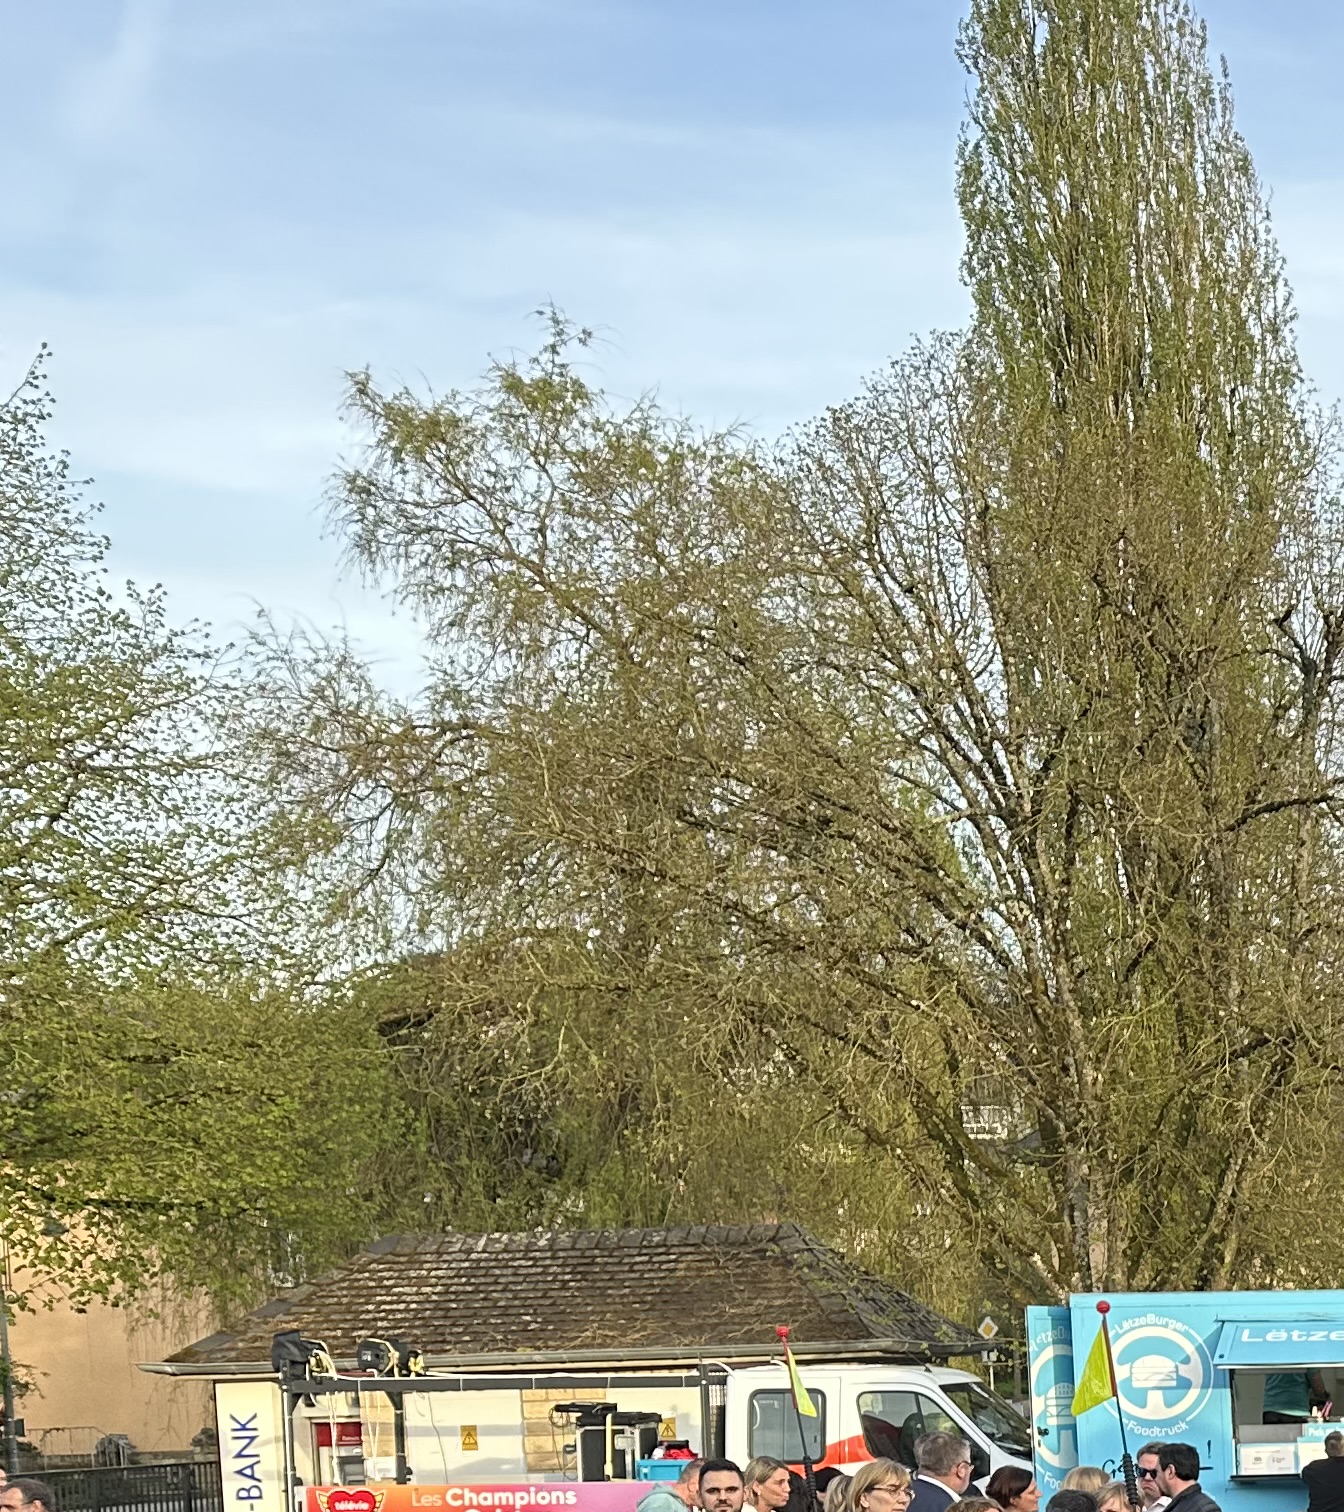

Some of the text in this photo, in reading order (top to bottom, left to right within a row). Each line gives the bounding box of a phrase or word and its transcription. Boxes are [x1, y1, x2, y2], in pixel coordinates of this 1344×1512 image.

[1126, 1420, 1190, 1437] Foodtruck
[411, 1486, 577, 1509] Les Champions
